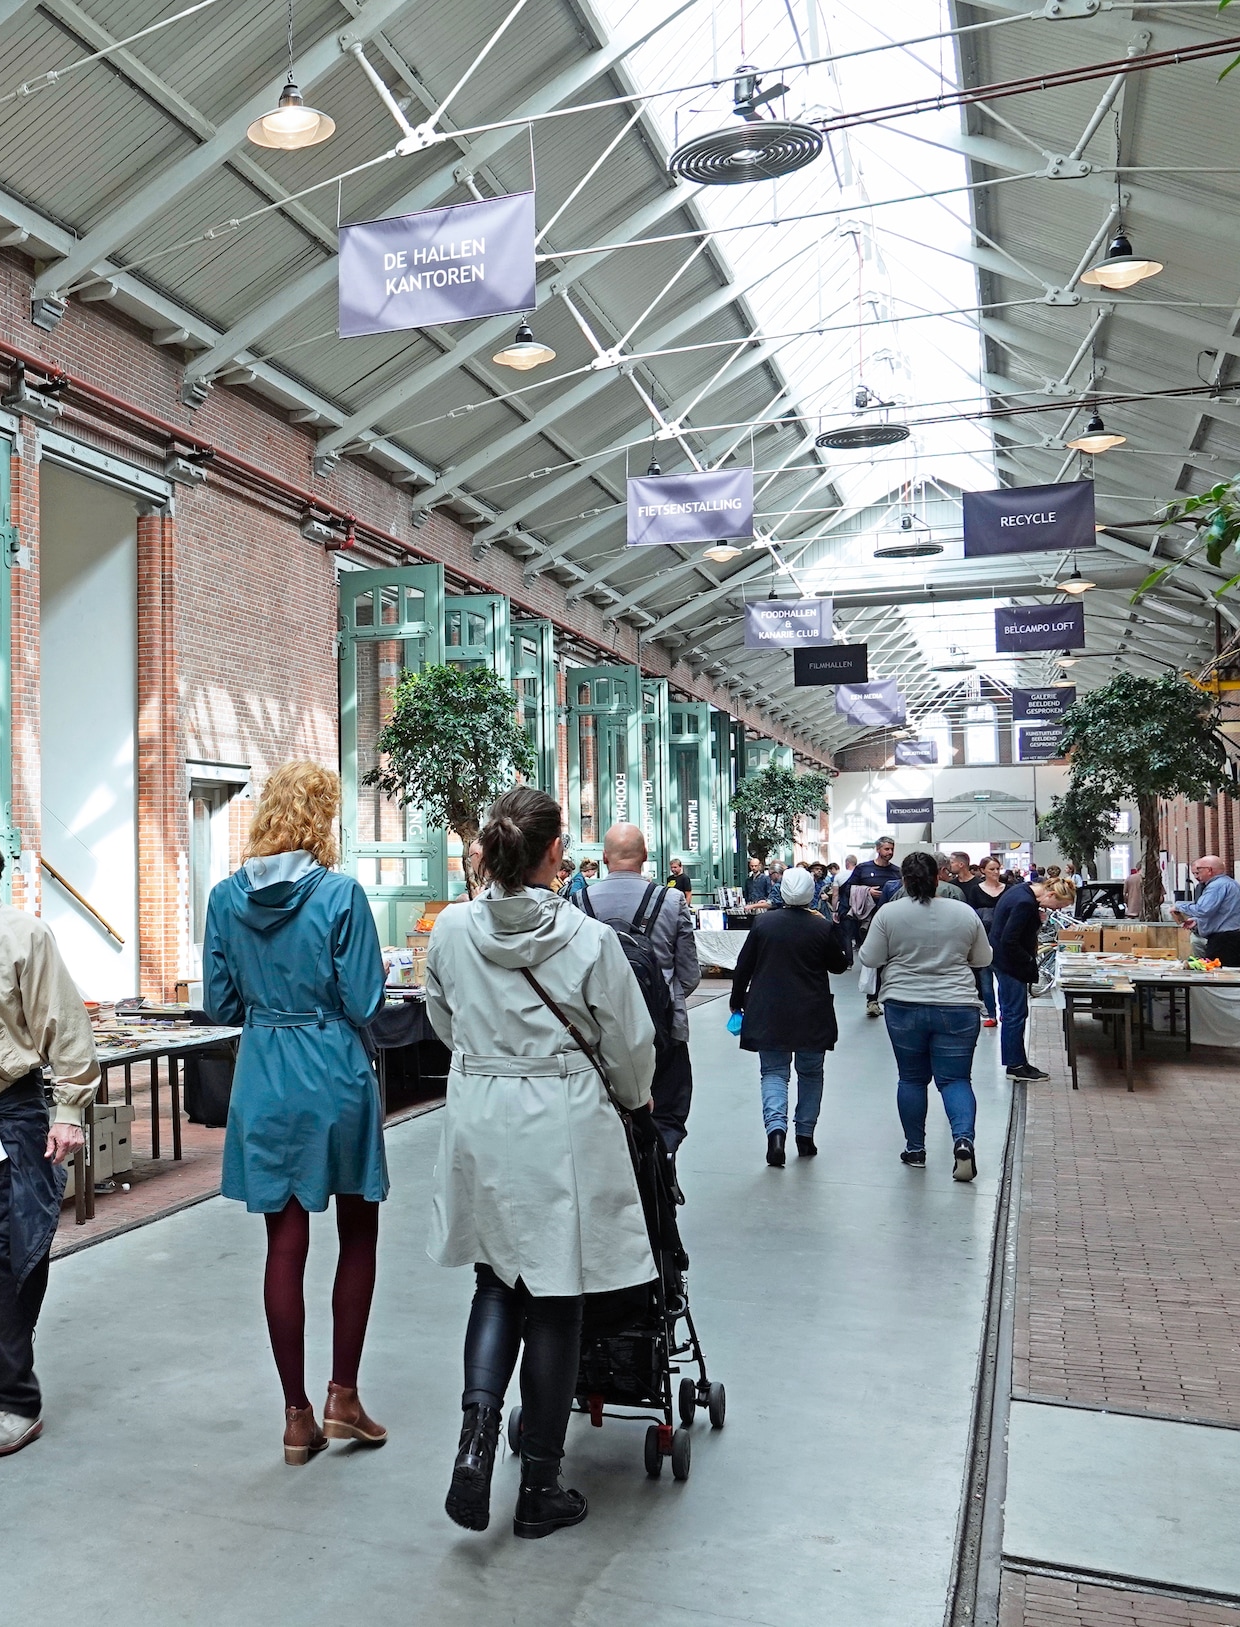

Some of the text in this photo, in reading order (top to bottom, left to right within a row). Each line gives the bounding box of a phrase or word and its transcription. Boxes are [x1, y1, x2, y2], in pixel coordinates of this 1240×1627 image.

[384, 237, 486, 271] DE HALLEN
[386, 263, 485, 296] KANTOREN
[638, 498, 742, 517] FIETSENSTALLING
[1000, 512, 1056, 527] RECYCLE
[761, 609, 817, 619] FOODHALLEN
[785, 620, 792, 628] &
[1004, 621, 1074, 634] BELCAMPO LOFT
[758, 629, 819, 640] KANARIE CLUB
[809, 661, 853, 669] FILMHALLEN
[616, 773, 627, 823] FOODHAL
[688, 799, 699, 853] FILMHALLEN
